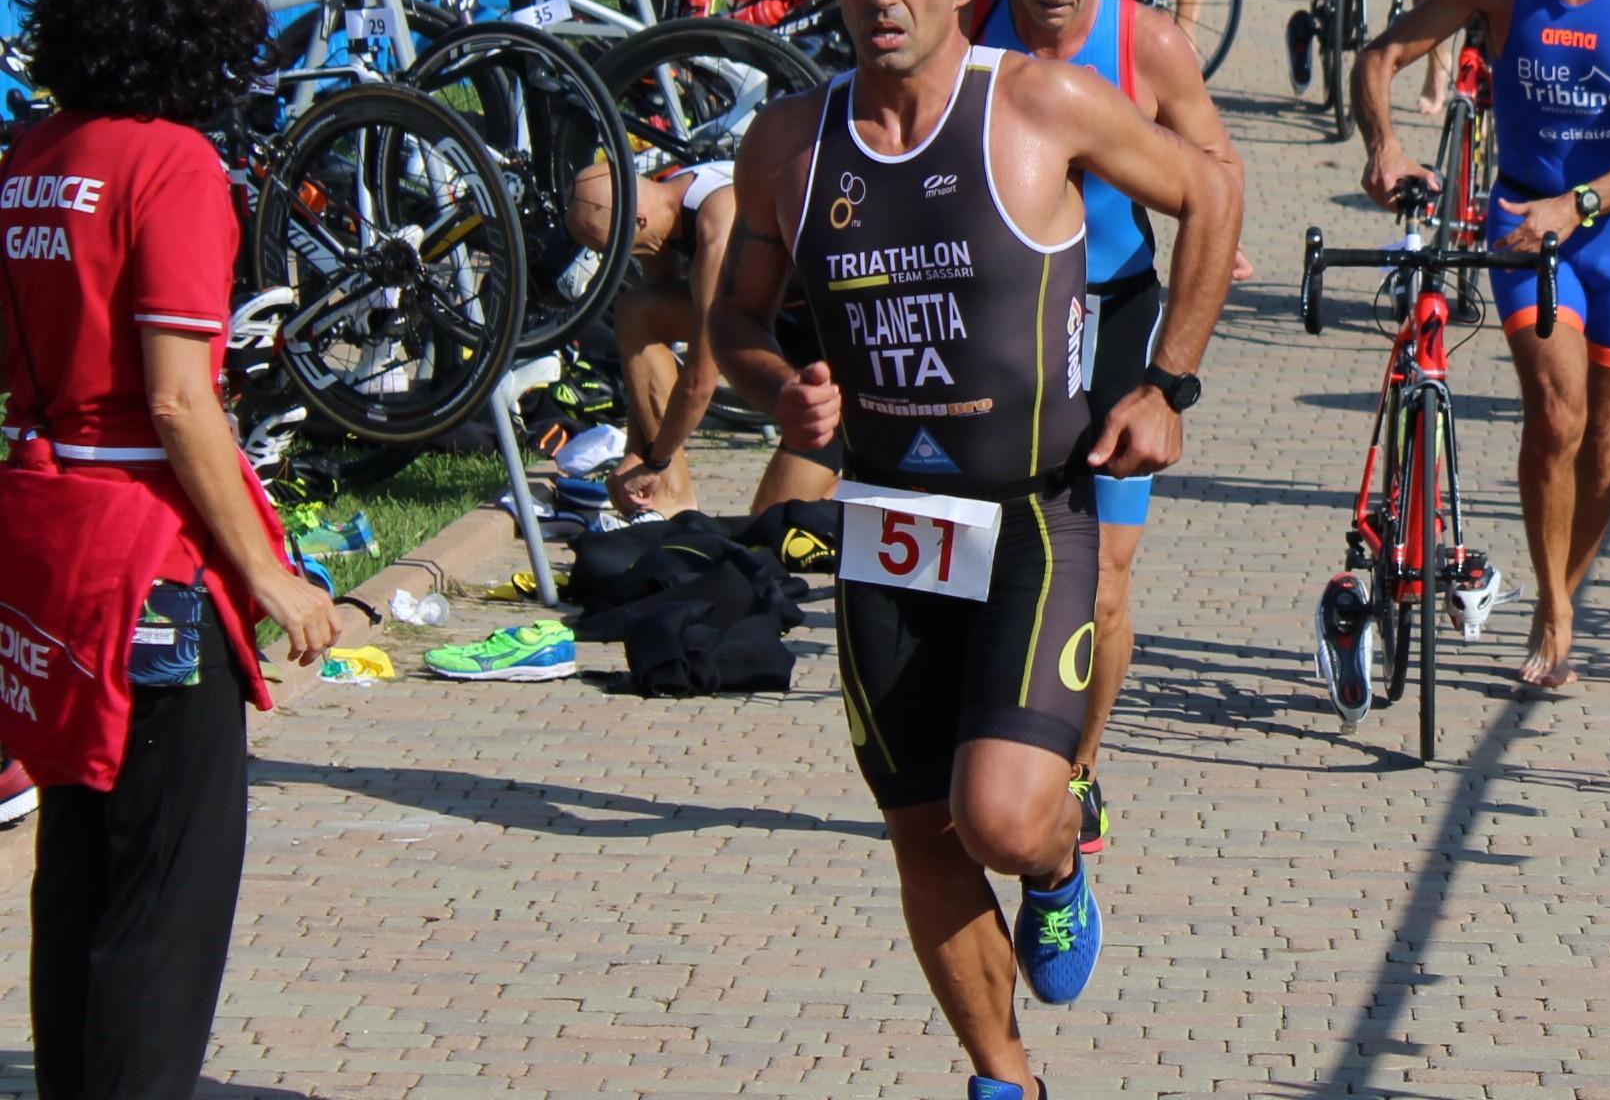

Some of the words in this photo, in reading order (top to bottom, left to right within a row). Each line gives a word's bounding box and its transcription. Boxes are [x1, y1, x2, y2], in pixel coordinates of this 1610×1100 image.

[368, 17, 386, 36] 29
[534, 5, 553, 25] 35
[1541, 27, 1598, 50] arena
[1517, 56, 1570, 82] Blue
[0, 175, 105, 214] GIUDICE
[6, 226, 72, 261] GARA
[826, 240, 972, 280] TRIATHLON
[892, 272, 923, 284] TEAM
[925, 266, 974, 282] SASSARI
[844, 292, 968, 345] PLANETTA
[868, 346, 956, 387] ITA
[878, 509, 956, 582] 51
[0, 623, 50, 679] DICE
